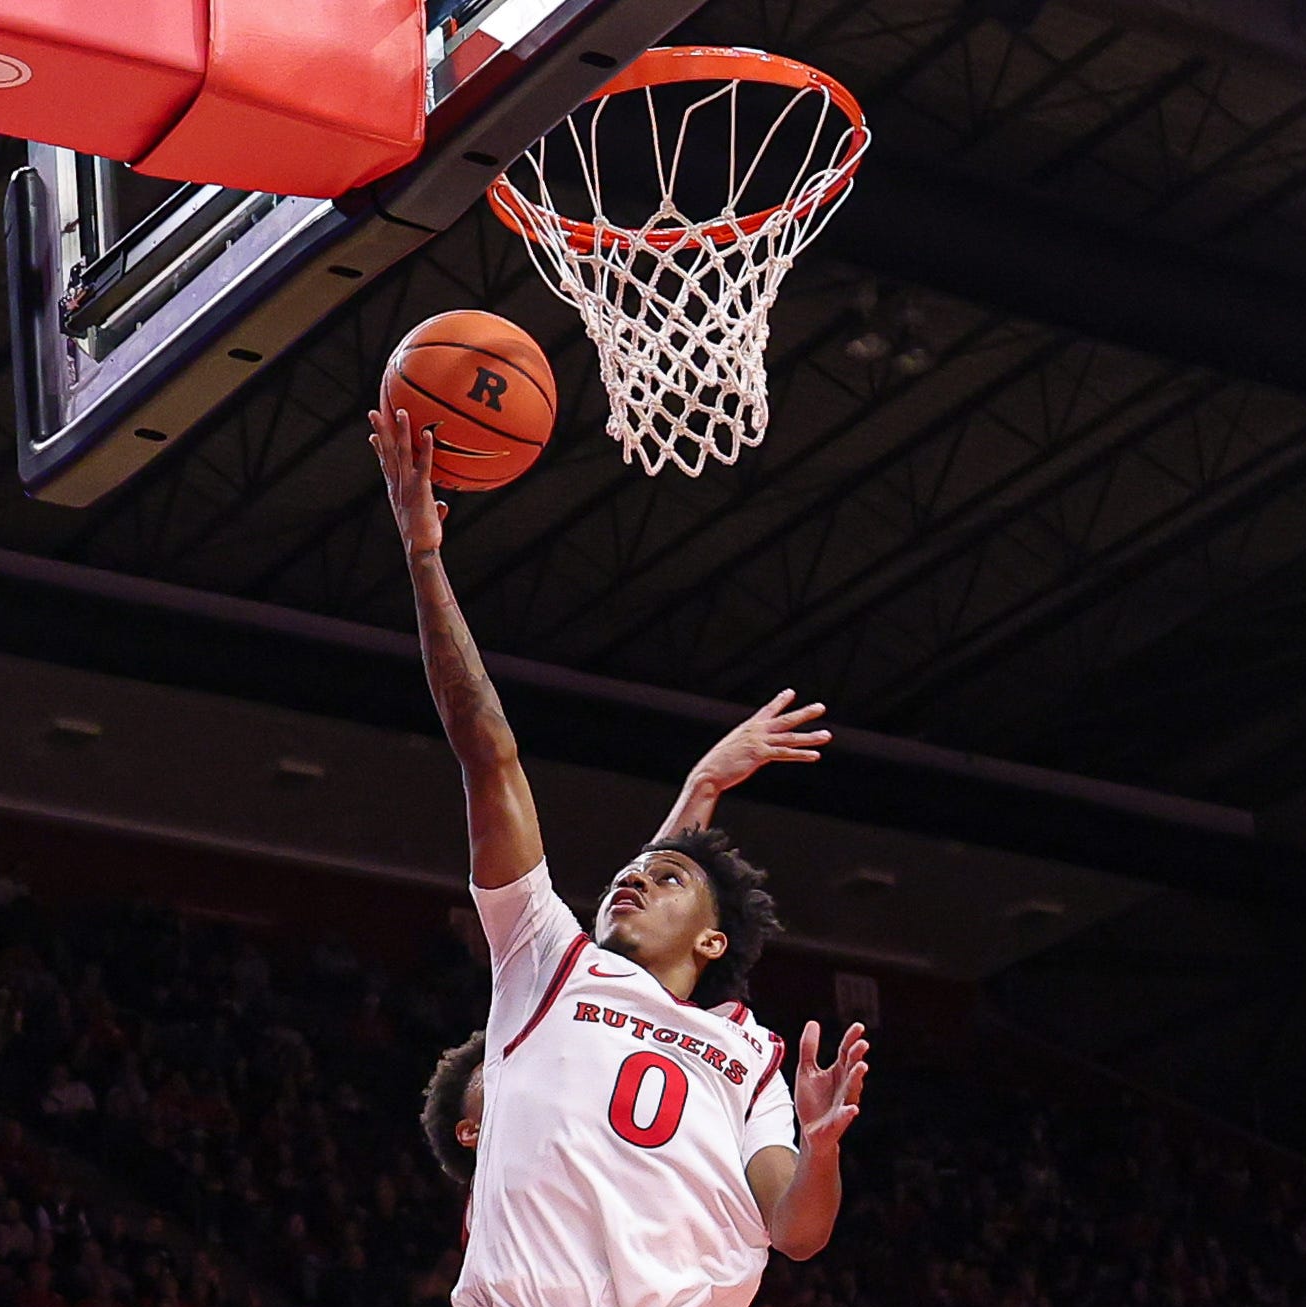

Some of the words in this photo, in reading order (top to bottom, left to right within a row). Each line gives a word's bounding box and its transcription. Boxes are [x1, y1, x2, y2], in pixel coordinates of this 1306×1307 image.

[467, 366, 508, 412] R
[573, 1002, 749, 1085] RUTGERS
[608, 1051, 689, 1148] 0
